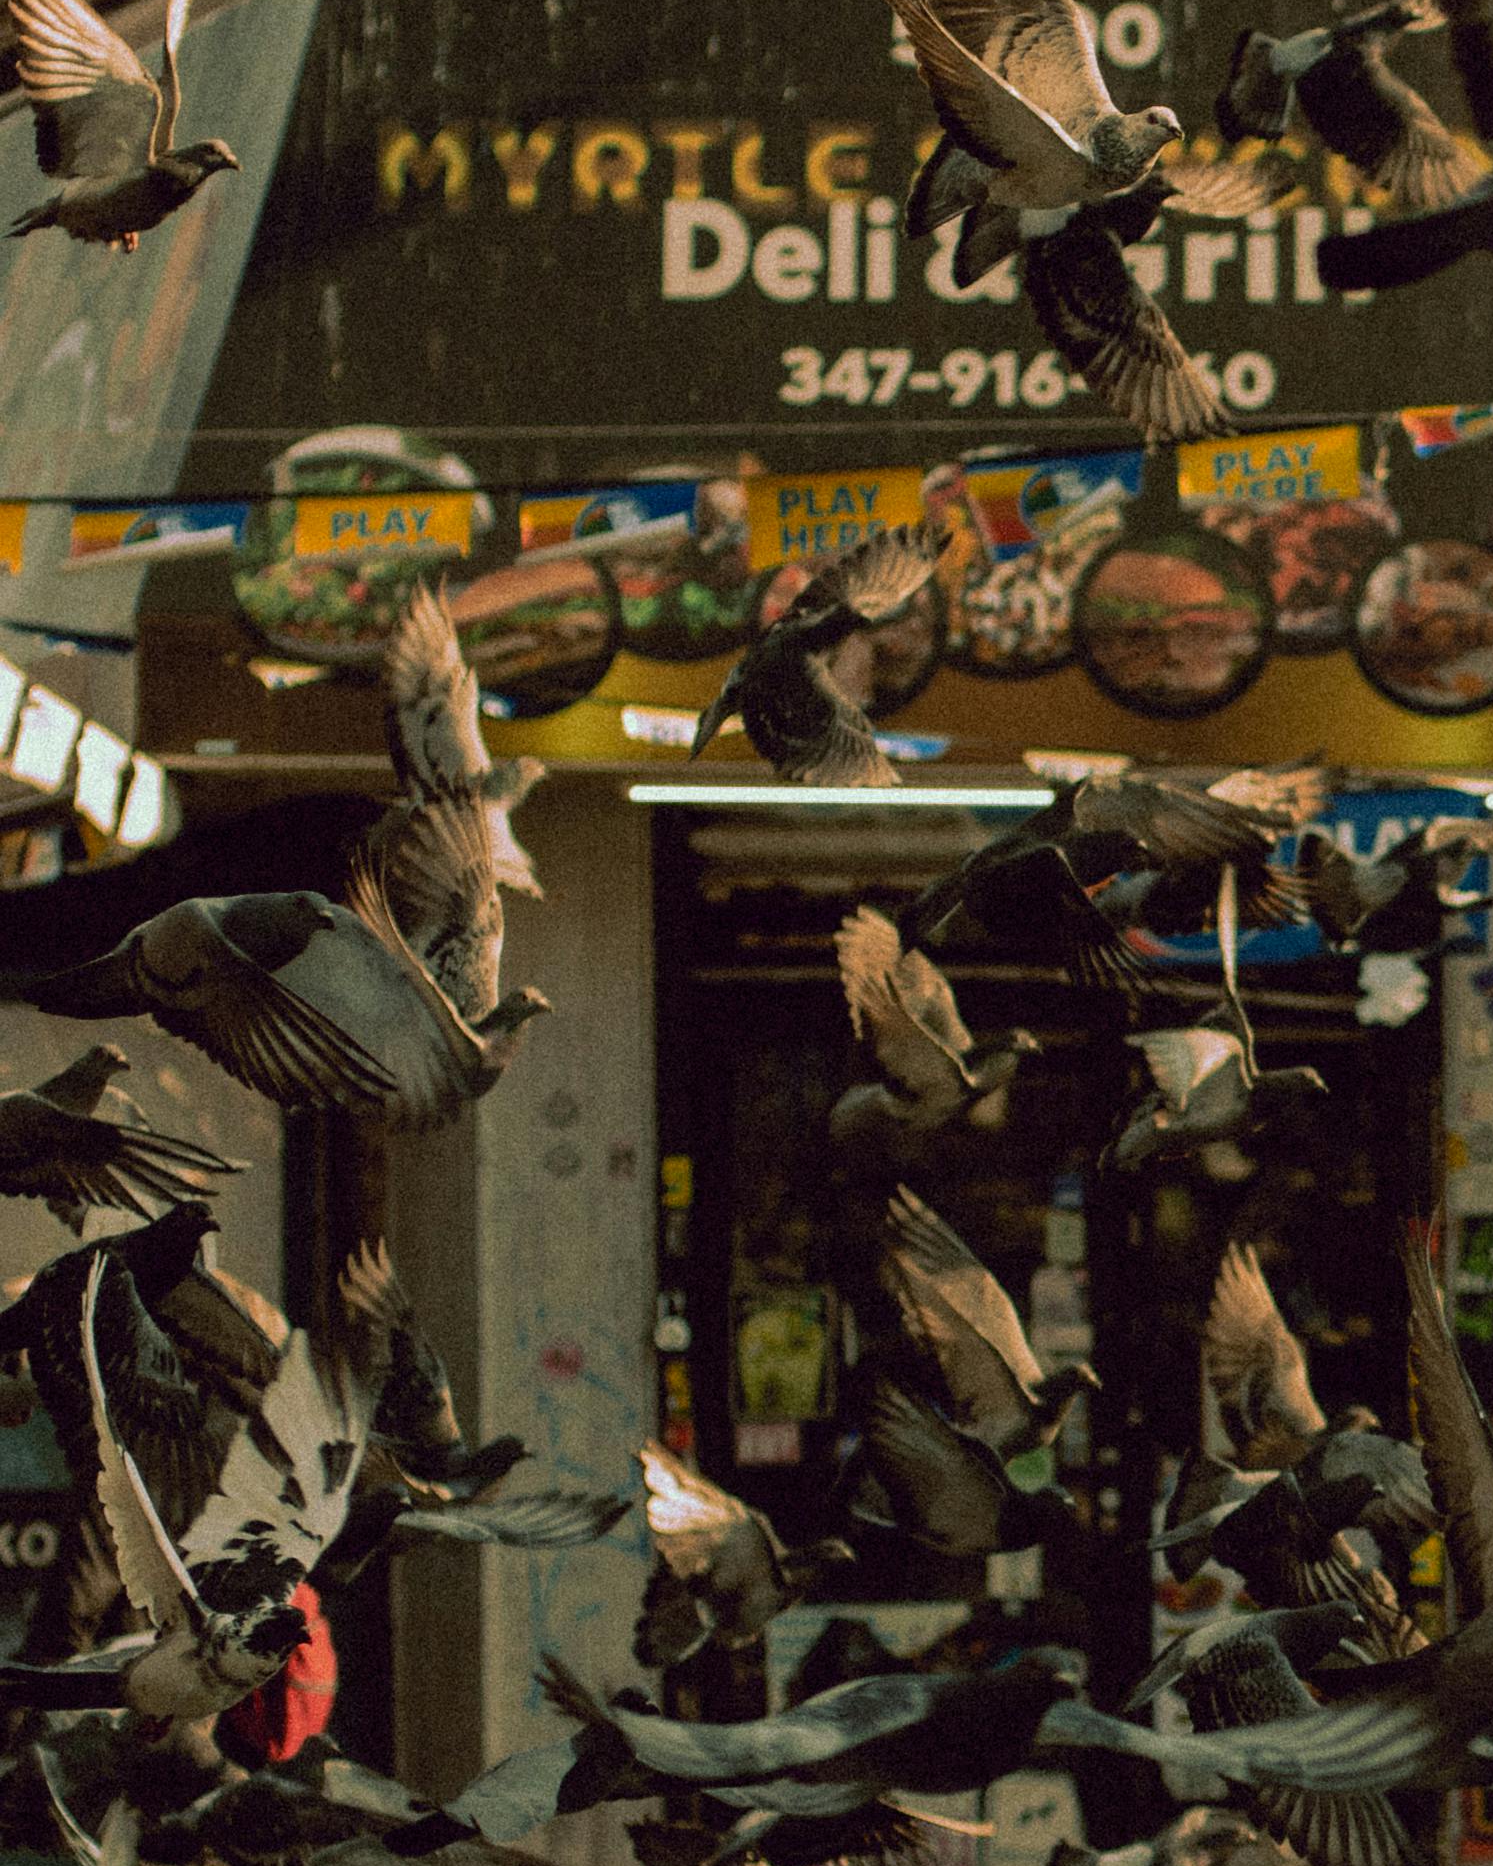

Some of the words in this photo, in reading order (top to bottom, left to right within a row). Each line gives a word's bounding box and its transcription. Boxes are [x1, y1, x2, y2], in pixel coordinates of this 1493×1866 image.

[661, 196, 898, 303] Deli
[1212, 442, 1316, 481] PLAY
[776, 483, 880, 519] PLAY
[329, 507, 435, 539] PLAY
